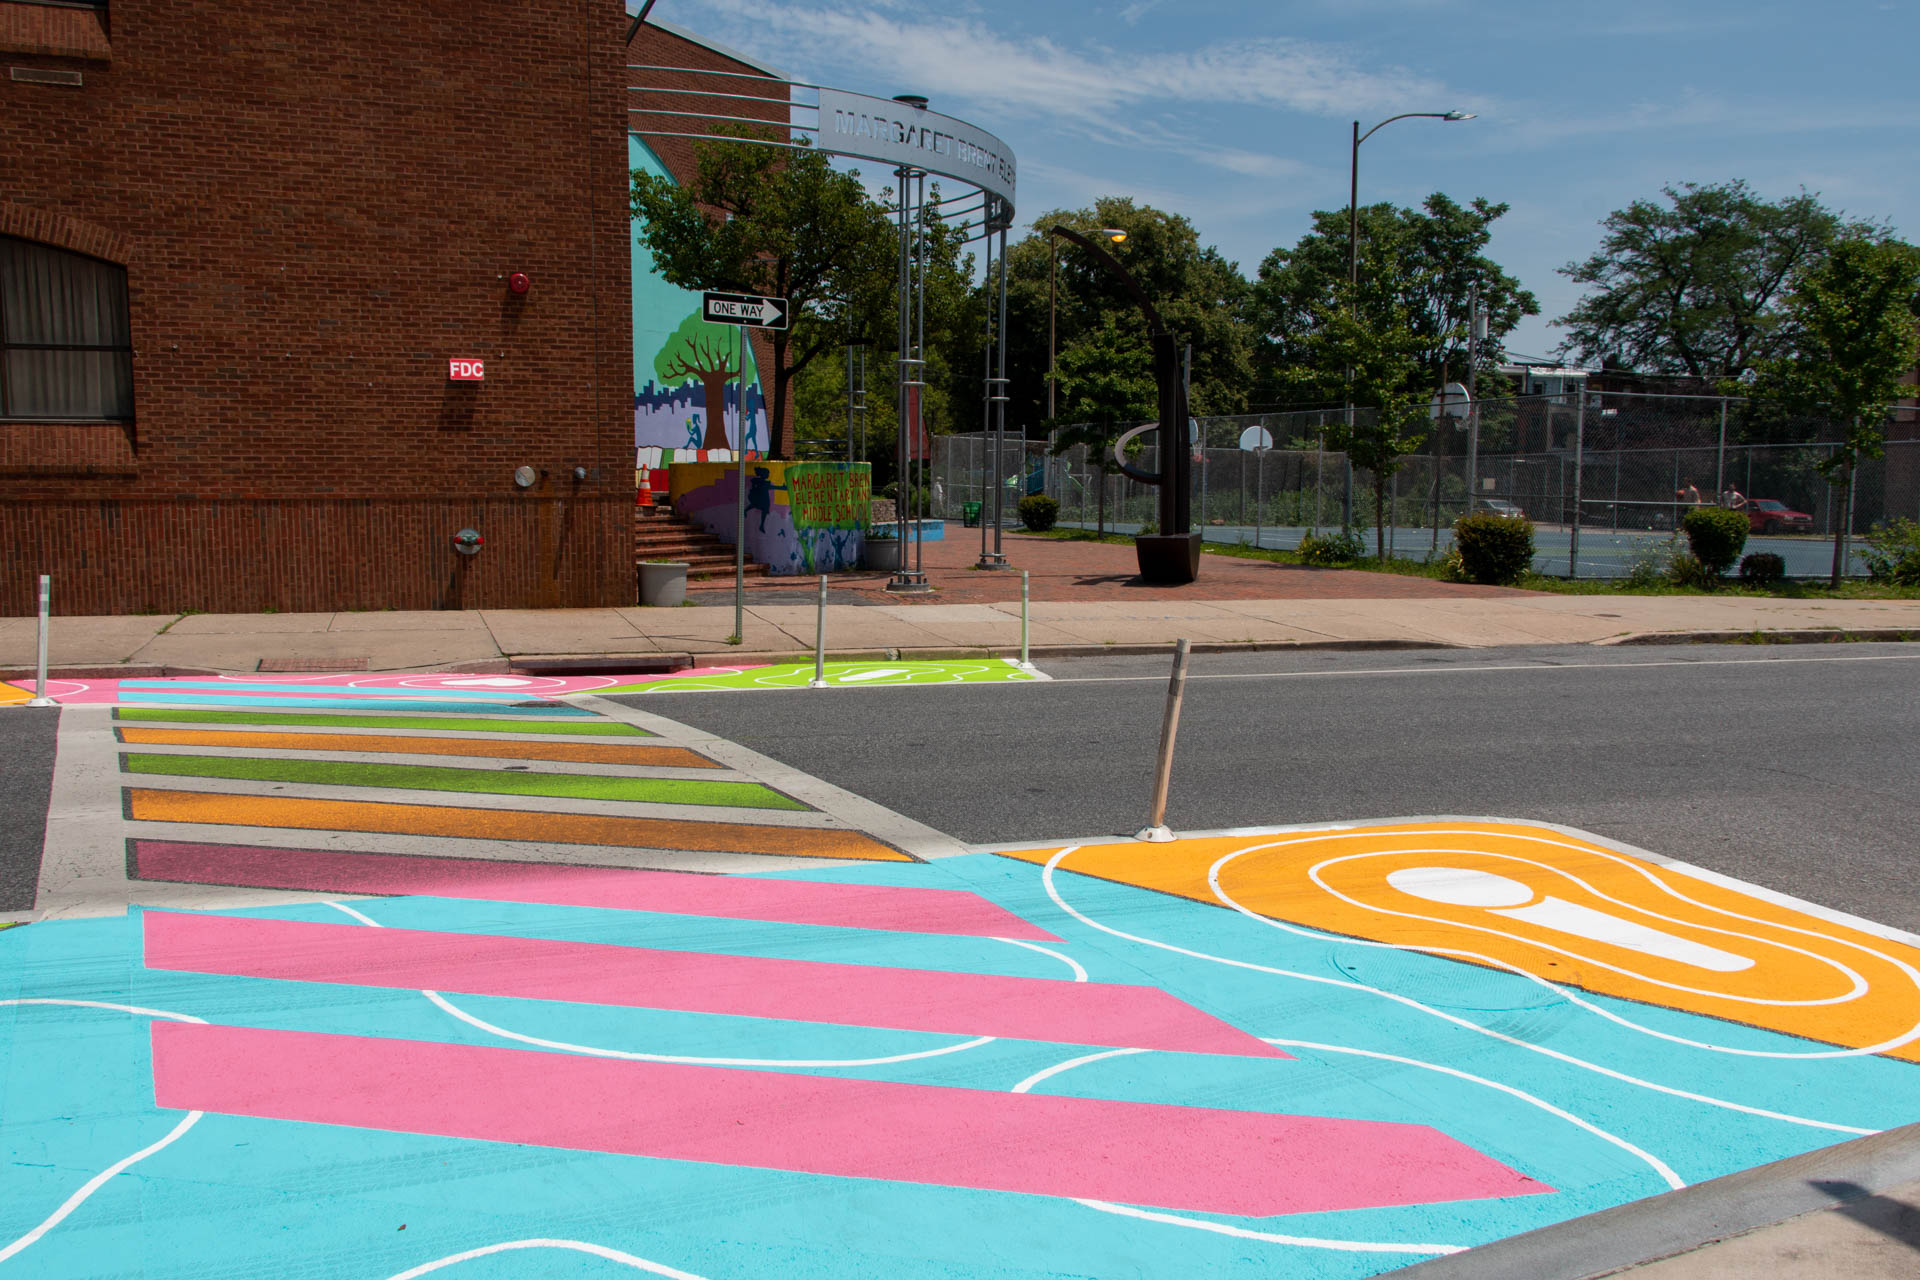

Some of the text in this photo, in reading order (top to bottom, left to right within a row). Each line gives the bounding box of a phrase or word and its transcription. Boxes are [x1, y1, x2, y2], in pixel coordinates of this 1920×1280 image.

[835, 109, 953, 157] MARGARET
[958, 138, 997, 174] BRENT
[713, 301, 764, 318] ONE WAY
[450, 362, 484, 377] FDC
[792, 472, 844, 491] MARGARET
[795, 488, 854, 504] ELEMENTARY
[803, 504, 868, 522] MIDDLE SCHOOL
